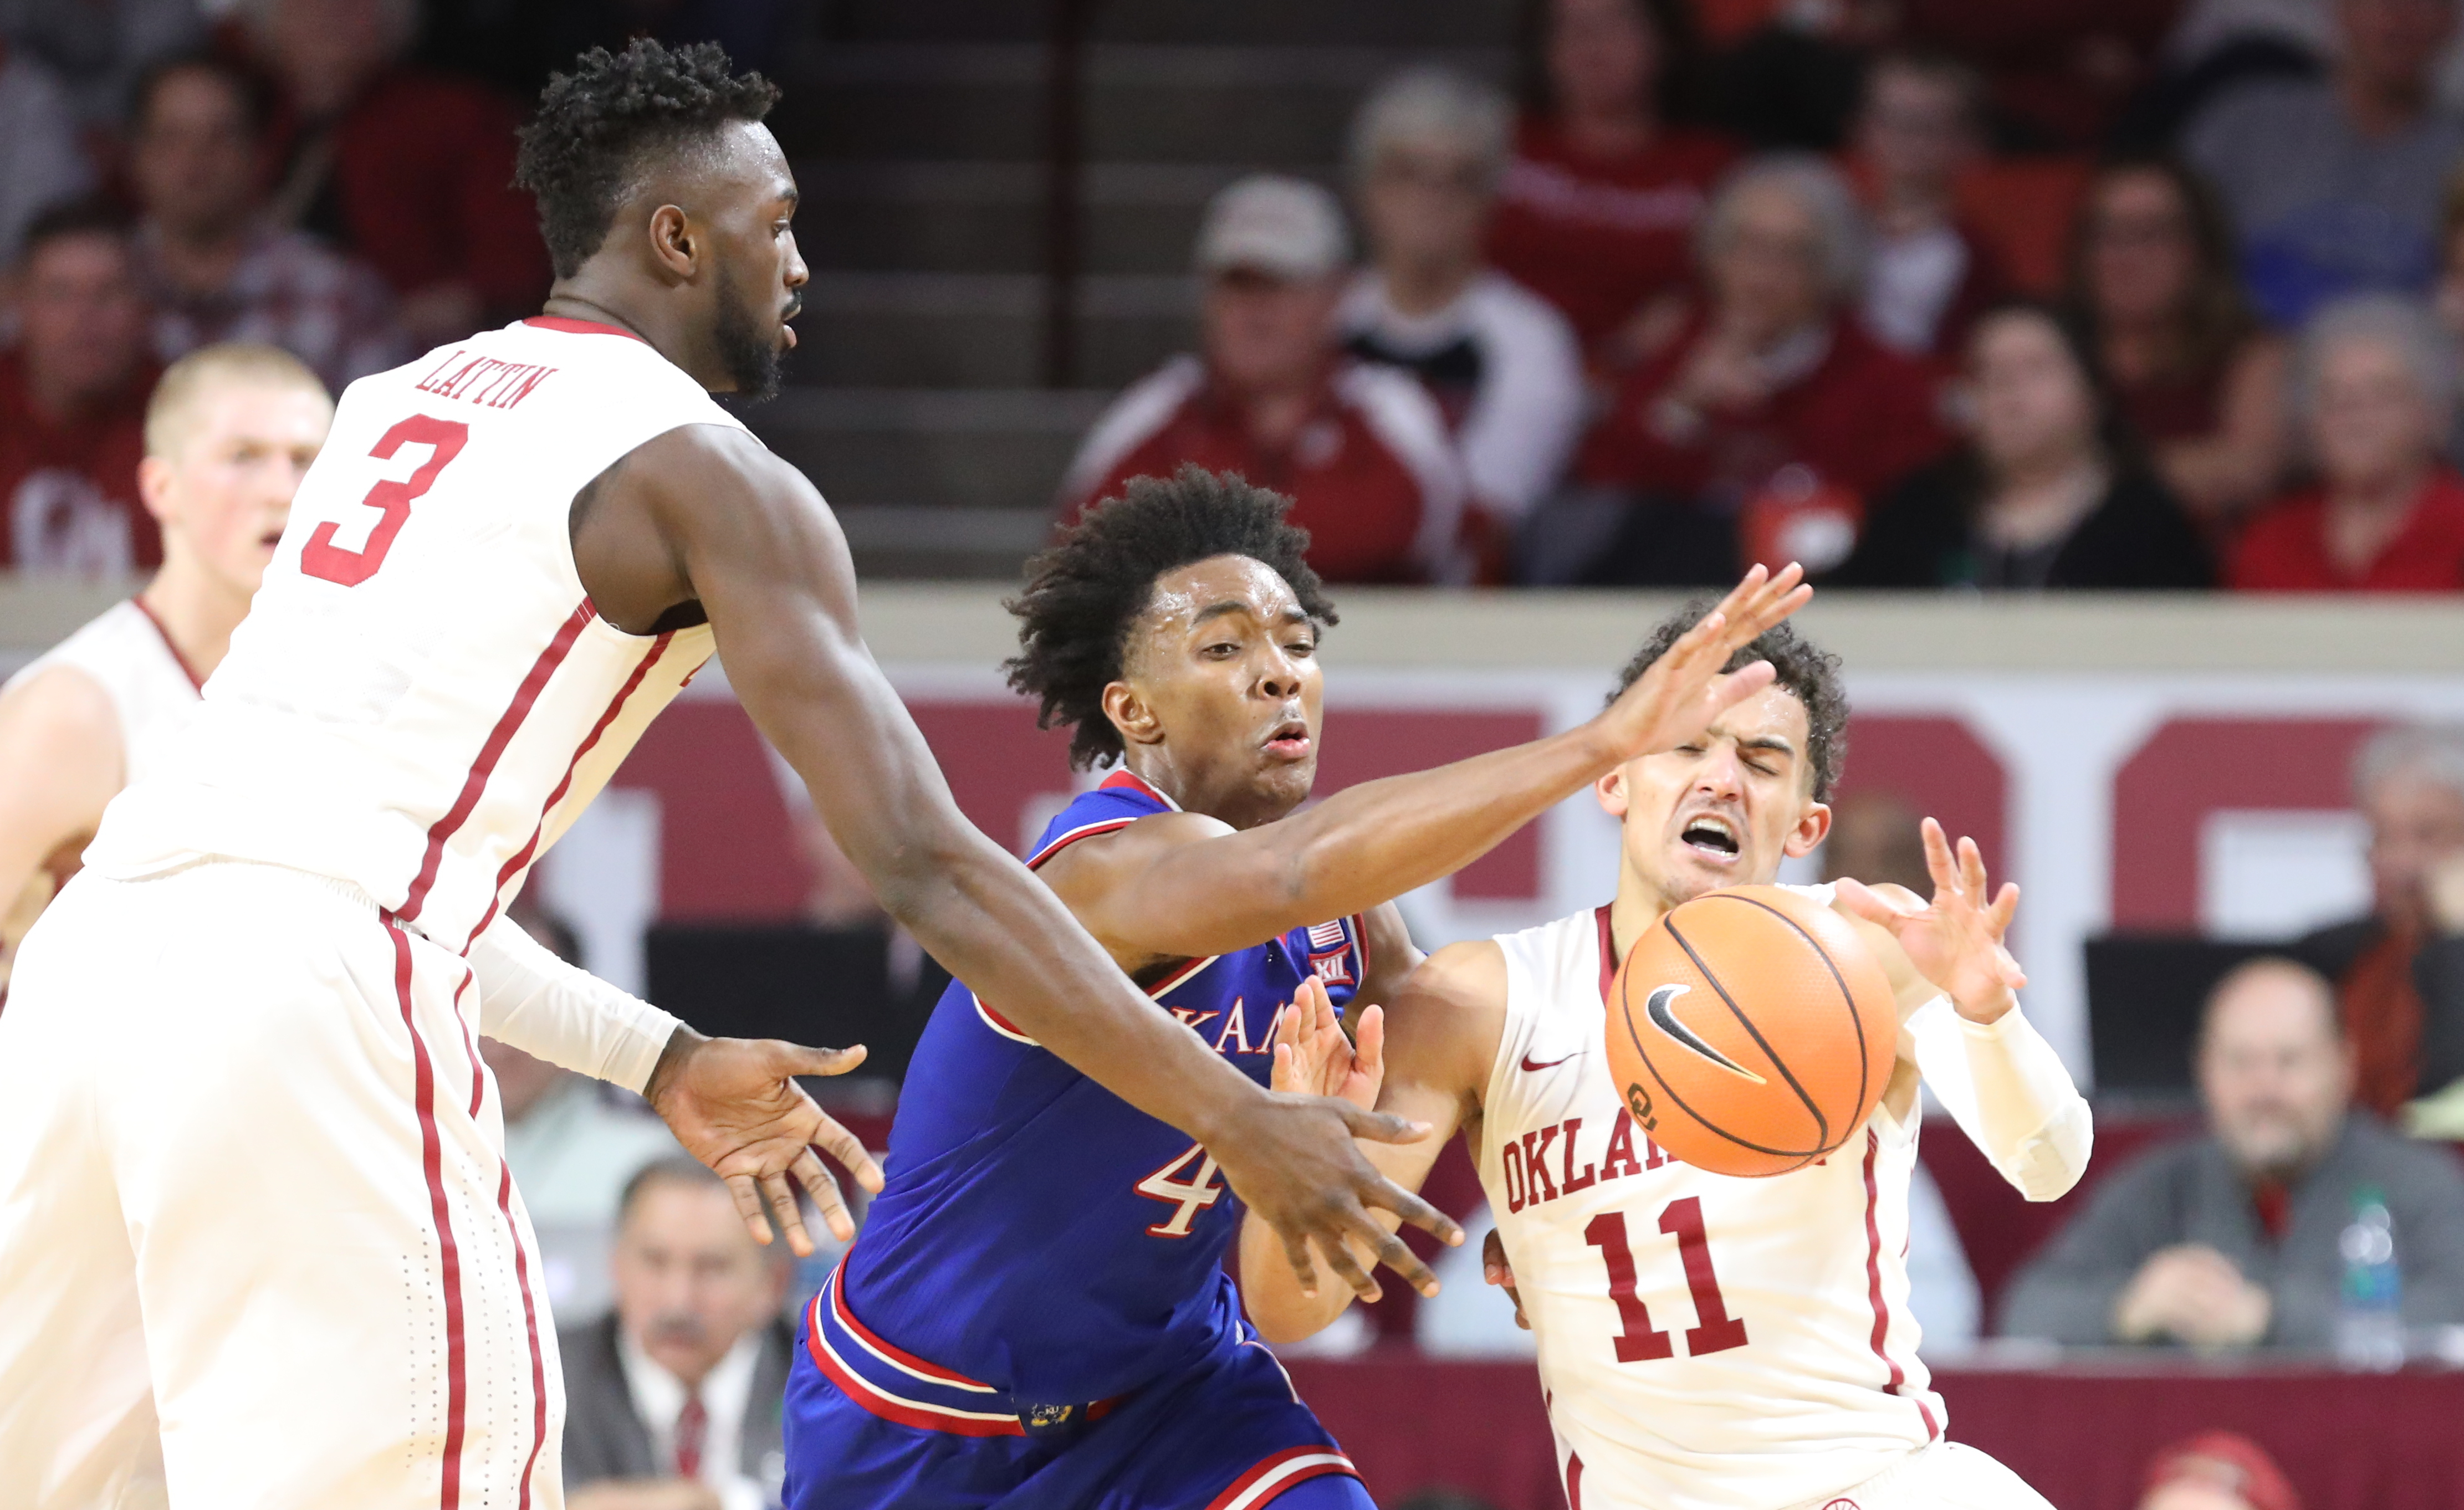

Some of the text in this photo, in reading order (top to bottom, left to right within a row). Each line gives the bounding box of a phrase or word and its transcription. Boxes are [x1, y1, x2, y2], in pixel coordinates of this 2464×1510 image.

[415, 350, 559, 410] LATTIN
[301, 413, 469, 587] 3
[1133, 1140, 1224, 1240] 4
[1584, 1196, 1749, 1363] 11
